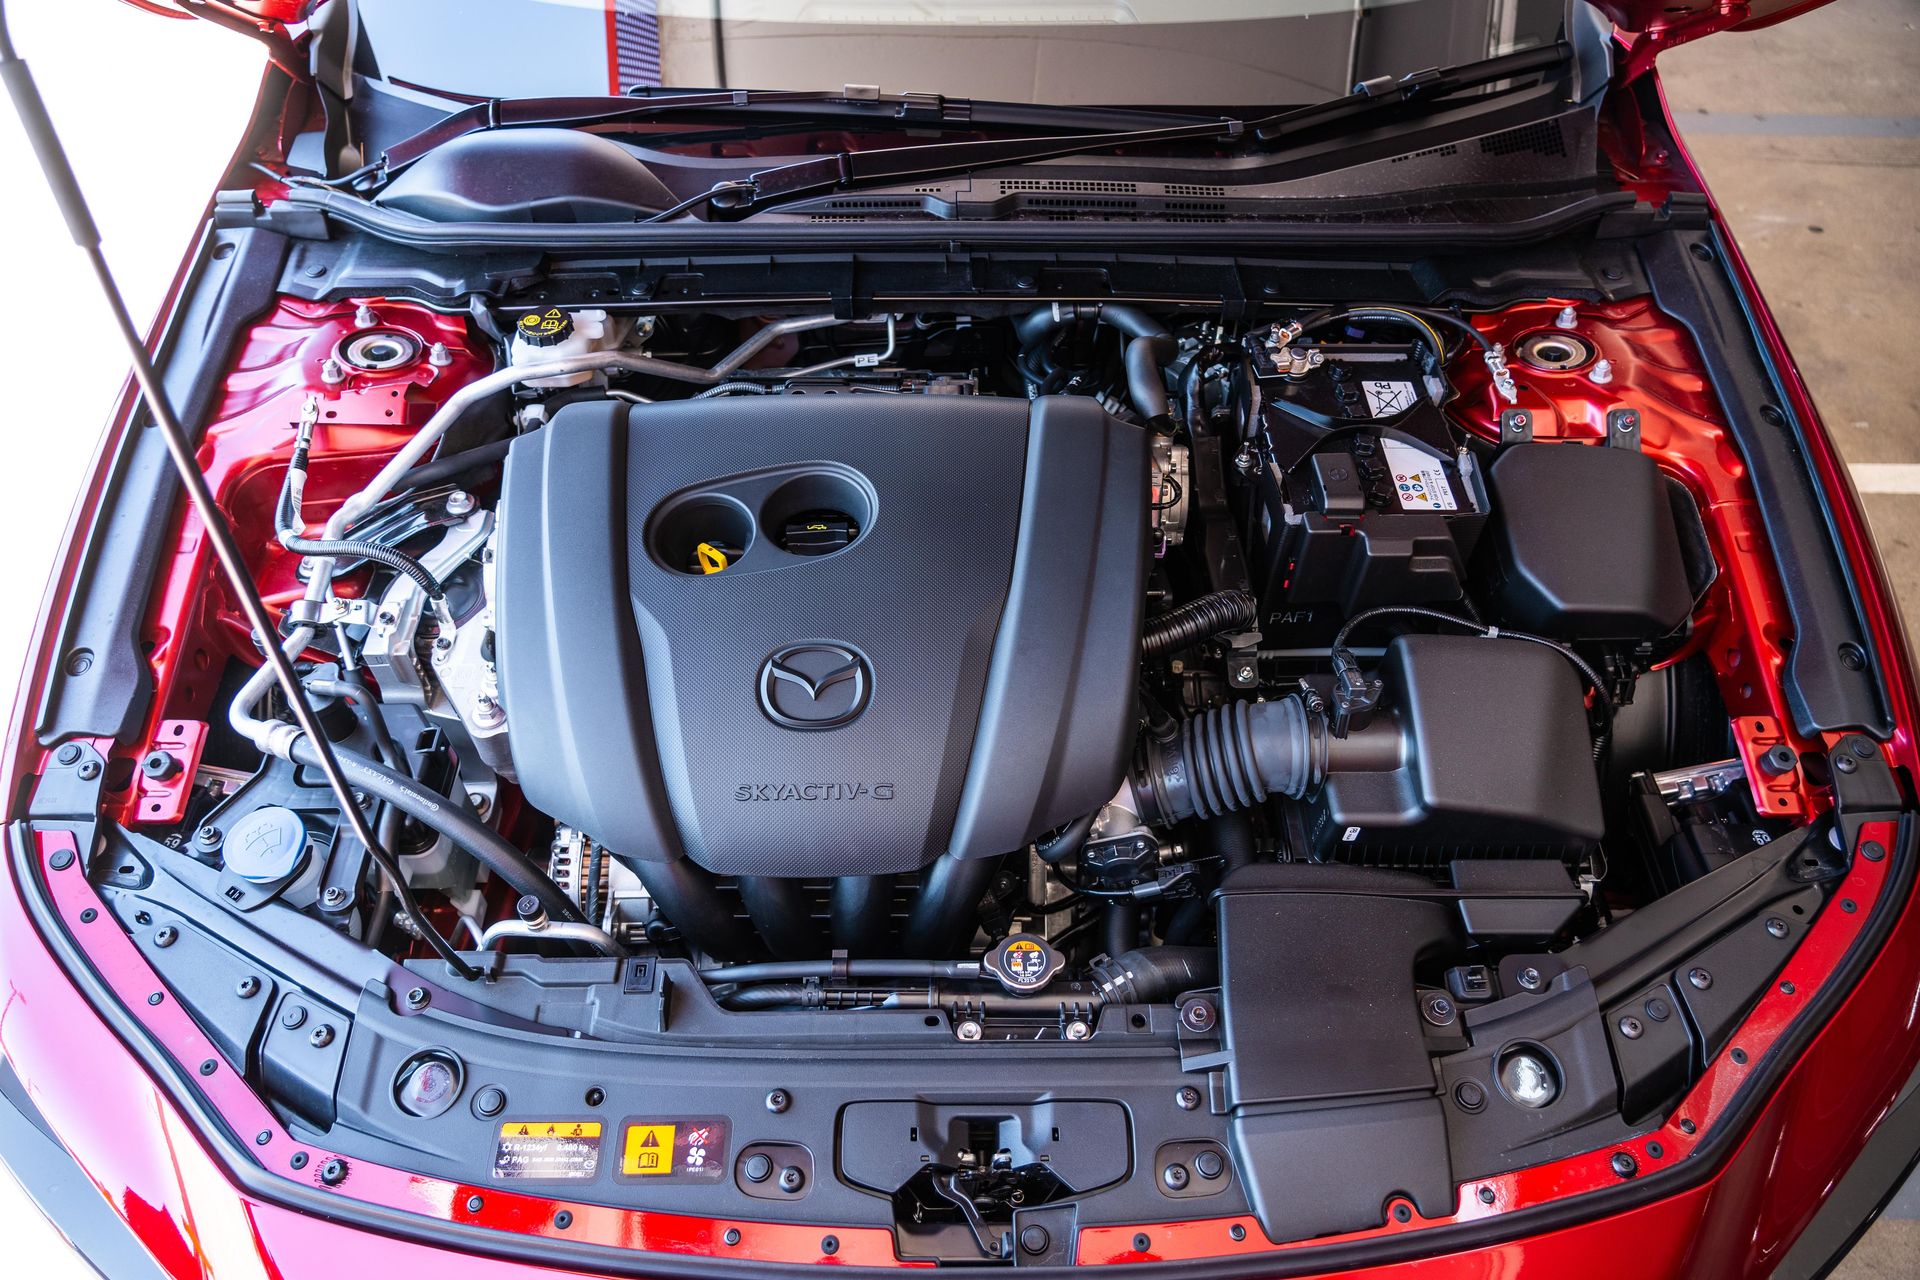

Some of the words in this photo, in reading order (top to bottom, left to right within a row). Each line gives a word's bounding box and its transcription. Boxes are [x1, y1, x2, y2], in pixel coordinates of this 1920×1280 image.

[1269, 611, 1312, 624] PAF1
[361, 767, 394, 785] GALAXY
[734, 783, 894, 801] SKYACTIV-G
[511, 1156, 529, 1164] PAG
